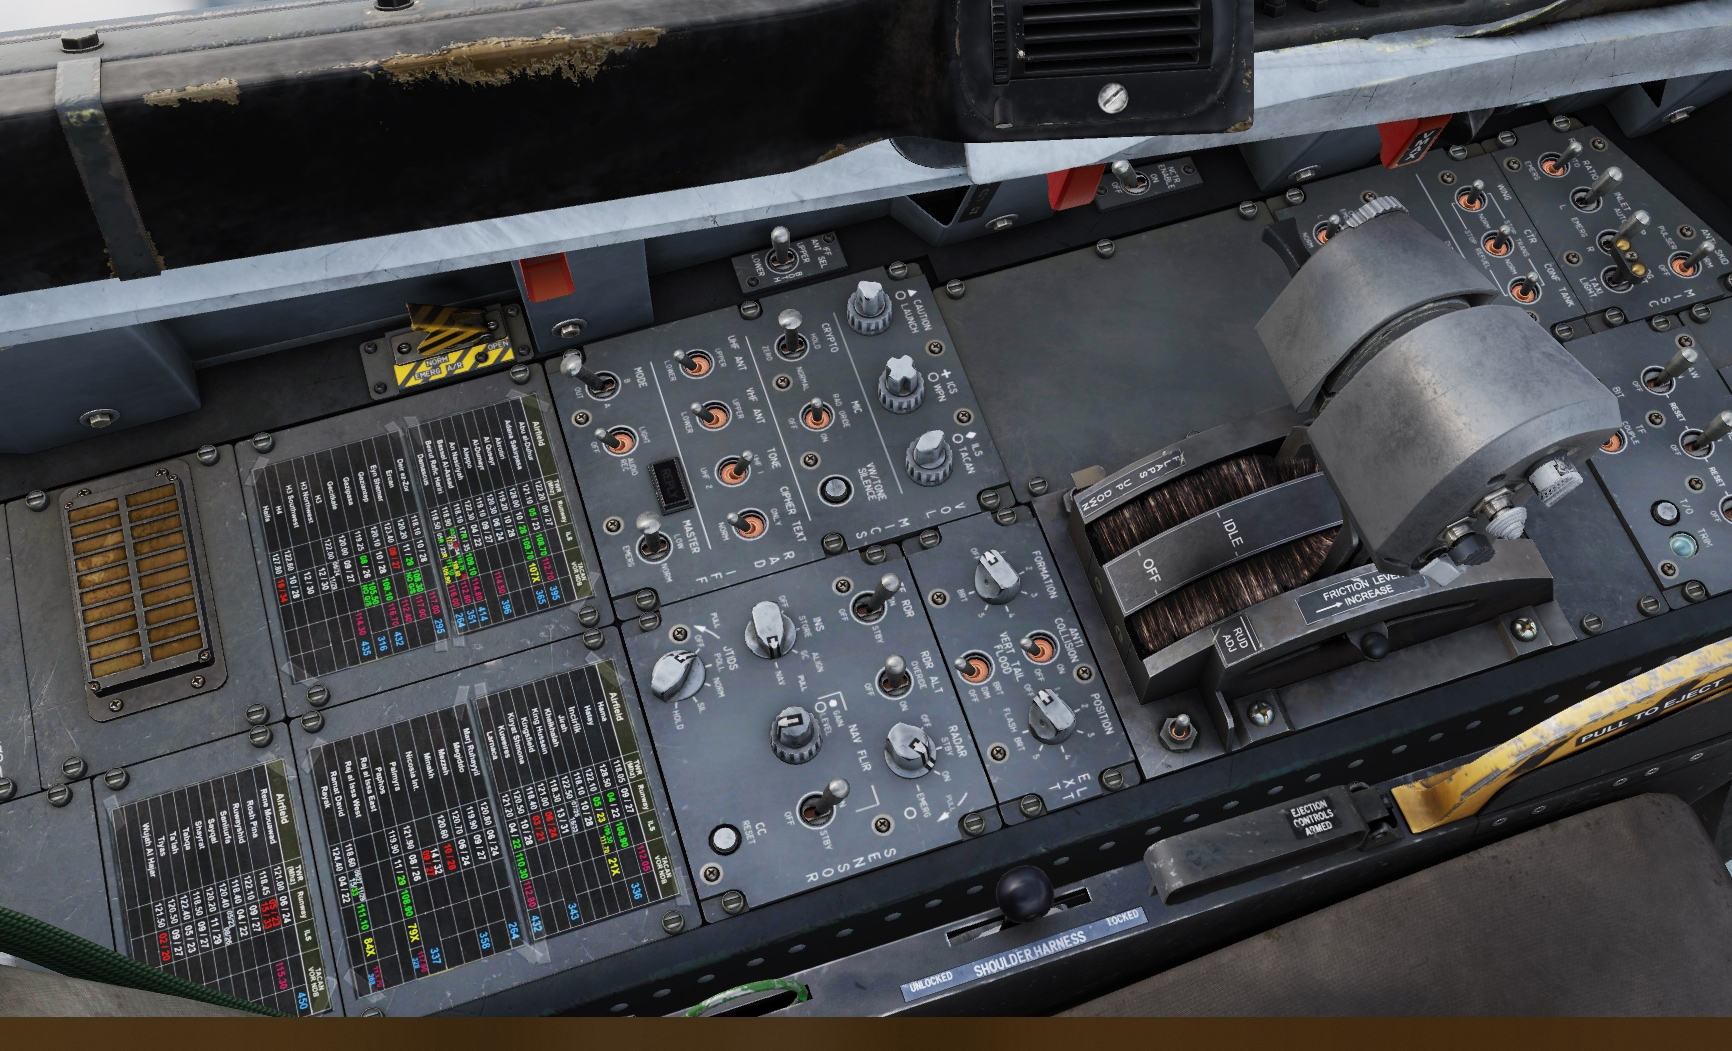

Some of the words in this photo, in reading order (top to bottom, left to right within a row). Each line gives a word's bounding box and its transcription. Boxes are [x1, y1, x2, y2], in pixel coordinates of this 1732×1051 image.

[1157, 163, 1176, 189] ENABLE
[1168, 165, 1183, 185] NCTR
[1582, 160, 1599, 180] RATIO
[1523, 229, 1538, 244] CTR
[1657, 225, 1678, 250] PULSER
[797, 242, 810, 263] UPPER
[1475, 248, 1490, 269] REFUEL
[1516, 239, 1530, 257] TRANS
[751, 254, 765, 277] LOWER
[818, 256, 827, 269] SEL
[1543, 262, 1561, 283] CONF
[1558, 286, 1575, 308] TANK
[1579, 277, 1597, 298] LIGHT
[900, 302, 920, 334] LAUNCH
[912, 299, 932, 331] CAUTION
[488, 340, 509, 351] OPEN
[809, 333, 821, 350] HOLD
[821, 322, 840, 353] CRYPTO
[426, 356, 448, 367] NORM
[715, 348, 727, 368] UPPER
[727, 334, 739, 353] UHF
[734, 354, 748, 371] ANT
[761, 346, 774, 361] ZERO
[414, 367, 440, 380] EMERG
[634, 366, 648, 389] MODE
[663, 359, 676, 381] LOWER
[795, 366, 810, 392] NORMAL
[832, 392, 842, 409] RAD
[932, 382, 947, 403] WPN
[732, 399, 744, 420] UPPER
[745, 386, 758, 404] VHF
[753, 407, 766, 425] ANT
[850, 399, 864, 415] MIC
[1669, 402, 1686, 423] RESET
[531, 420, 545, 447] Airfield
[680, 411, 694, 435] LOWER
[1621, 420, 1640, 446] COUPLE
[638, 425, 651, 444] LIGHT
[766, 447, 779, 469] TONE
[970, 439, 983, 457] ILS
[416, 453, 429, 486] Damascus
[627, 457, 638, 476] AUDIO
[958, 445, 975, 475] TACAN
[1140, 455, 1180, 479] FLAPS
[858, 468, 878, 502] SILENCE
[866, 462, 888, 500] VW/TONE
[1709, 466, 1726, 488] RESET
[1082, 490, 1112, 511] DOWN
[770, 507, 781, 527] ONLY
[778, 485, 796, 516] CIPHER
[792, 520, 807, 543] TEXT
[674, 533, 685, 550] LOW
[681, 519, 700, 555] MASTER
[1222, 518, 1244, 548] IDLE
[1697, 528, 1714, 548] TRIM
[622, 545, 635, 568] EMERG
[527, 562, 540, 583] 107X
[660, 563, 674, 583] NORM
[1032, 550, 1059, 599] FORMATION
[1142, 558, 1162, 585] OFF
[535, 589, 546, 605] 365
[549, 585, 559, 601] 395
[1323, 579, 1369, 601] FRICTION
[1345, 585, 1394, 606] INCREASE
[477, 605, 488, 621] 414
[501, 599, 511, 615] 396
[901, 599, 915, 618] RDR
[433, 618, 444, 634] 295
[454, 612, 465, 628] 264
[798, 615, 811, 638] STORE
[812, 616, 825, 632] INS
[377, 635, 387, 651] 316
[393, 630, 403, 646] 432
[871, 625, 885, 643] STBY
[1054, 617, 1080, 663] COLLISION
[1068, 626, 1085, 648] ANTI
[1222, 634, 1238, 654] ADJ
[1232, 626, 1250, 650] RUD
[360, 640, 370, 656] 435
[722, 645, 739, 672] JTIDS
[999, 631, 1016, 653] VERT
[1011, 661, 1024, 682] TAIL
[713, 652, 724, 672] POLL
[811, 651, 825, 673] ALIGN
[994, 645, 1012, 675] FLOOD
[774, 670, 786, 686] NAV
[921, 650, 934, 669] RDR
[929, 676, 943, 693] ALT
[1034, 668, 1046, 682] OFF
[713, 677, 726, 698] NORM
[980, 686, 991, 700] DIM
[582, 704, 595, 726] Hatay
[596, 700, 608, 721] Hama
[608, 691, 623, 721] Airfield
[1091, 692, 1115, 736] POSITION
[1581, 720, 1629, 744] PULL
[1634, 707, 1661, 721] TO
[1664, 678, 1725, 707] EJECT
[672, 709, 684, 731] HOLD
[820, 713, 833, 737] LEVEL
[833, 710, 845, 728] GAIN
[920, 713, 933, 728] OFF
[1003, 707, 1017, 733] FLASH
[486, 730, 499, 760] Larnaca
[520, 716, 536, 753] Kingsfield
[948, 724, 968, 758] RADAR
[848, 723, 863, 744] NAV
[856, 750, 873, 772] FLIR
[941, 736, 956, 756] STBY
[404, 750, 417, 778] Nicosia
[423, 751, 435, 779] Minakh
[612, 758, 625, 783] 118.05
[374, 766, 387, 795] Paphos
[584, 767, 597, 792] 122.10
[275, 791, 289, 824] Airfield
[320, 785, 331, 808] Rayak
[636, 783, 649, 810] Runway
[916, 792, 932, 818] EMERG
[245, 799, 256, 820] Rosh
[1291, 799, 1328, 818] EJECTION
[1293, 809, 1334, 828] CONTROLS
[230, 802, 245, 844] Ruwayshid
[742, 819, 757, 845] RESET
[755, 822, 767, 836] CC
[141, 822, 153, 850] Wujah
[193, 820, 205, 850] Shayrat
[614, 821, 629, 848] 108.90
[820, 829, 834, 851] STBY
[146, 856, 157, 878] Hajar
[514, 852, 528, 879] 110.30
[607, 856, 620, 876] 21X
[636, 844, 650, 872] 112.05
[806, 848, 897, 883] SENSOR
[258, 869, 270, 896] 118.45
[630, 881, 643, 900] 336
[295, 890, 308, 919] Runway
[400, 888, 413, 917] 108.90
[567, 902, 579, 920] 343
[356, 902, 369, 931] 111.10
[530, 914, 542, 933] 432
[407, 922, 419, 942] 79X
[478, 931, 490, 949] 358
[507, 921, 519, 940] 264
[363, 936, 375, 957] 84X
[429, 946, 440, 965] 337
[973, 947, 1033, 978] SHOULDER
[1031, 930, 1087, 961] HARNESS
[274, 961, 288, 991] 115.30
[908, 971, 954, 993] UNLOCKED
[296, 990, 308, 1010] 450
